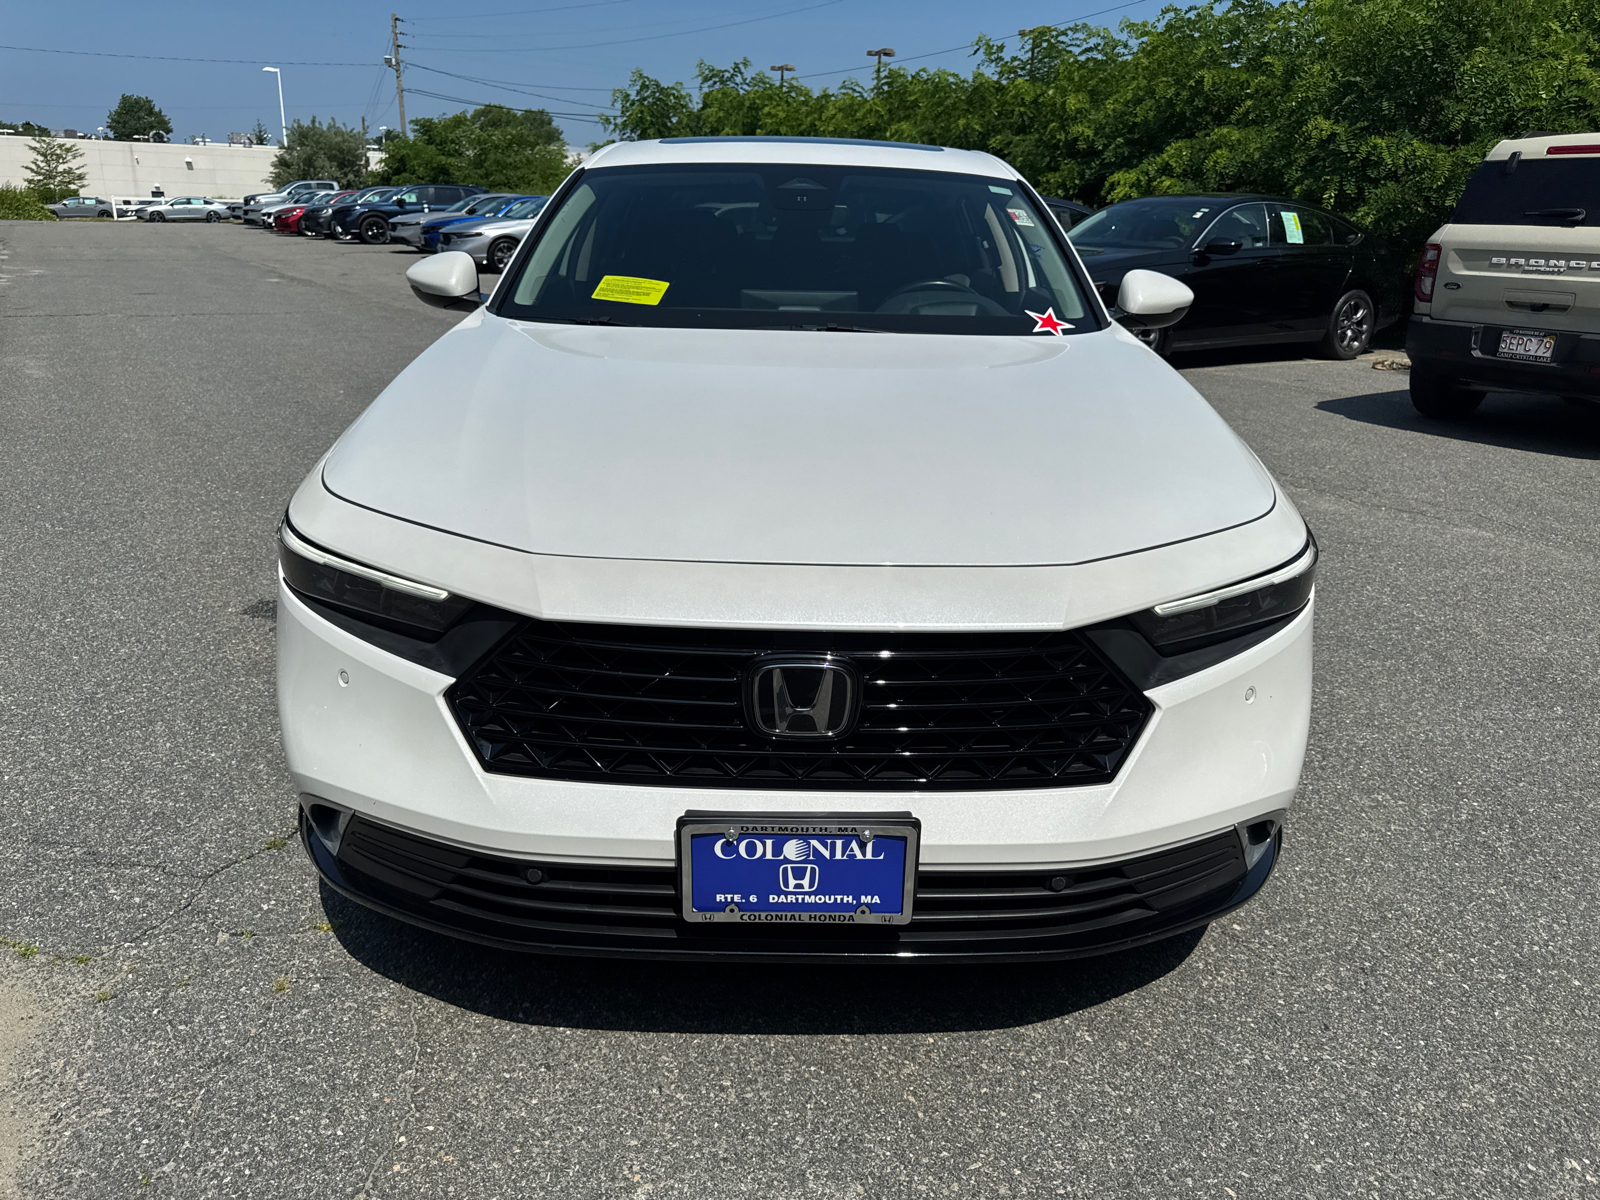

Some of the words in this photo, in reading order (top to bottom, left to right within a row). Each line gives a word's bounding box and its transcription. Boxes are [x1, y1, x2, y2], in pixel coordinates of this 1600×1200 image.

[1500, 335, 1533, 351] 5EPC
[1534, 339, 1553, 355] 79
[1512, 353, 1536, 361] CRYSTAL
[713, 838, 885, 861] COLONIAL
[715, 894, 746, 902] RTE.
[749, 894, 758, 903] 6
[768, 894, 857, 905] DARTMOUTH,
[860, 895, 881, 904] MA
[740, 913, 805, 922] COLONIAL
[808, 913, 856, 923] HONDA
